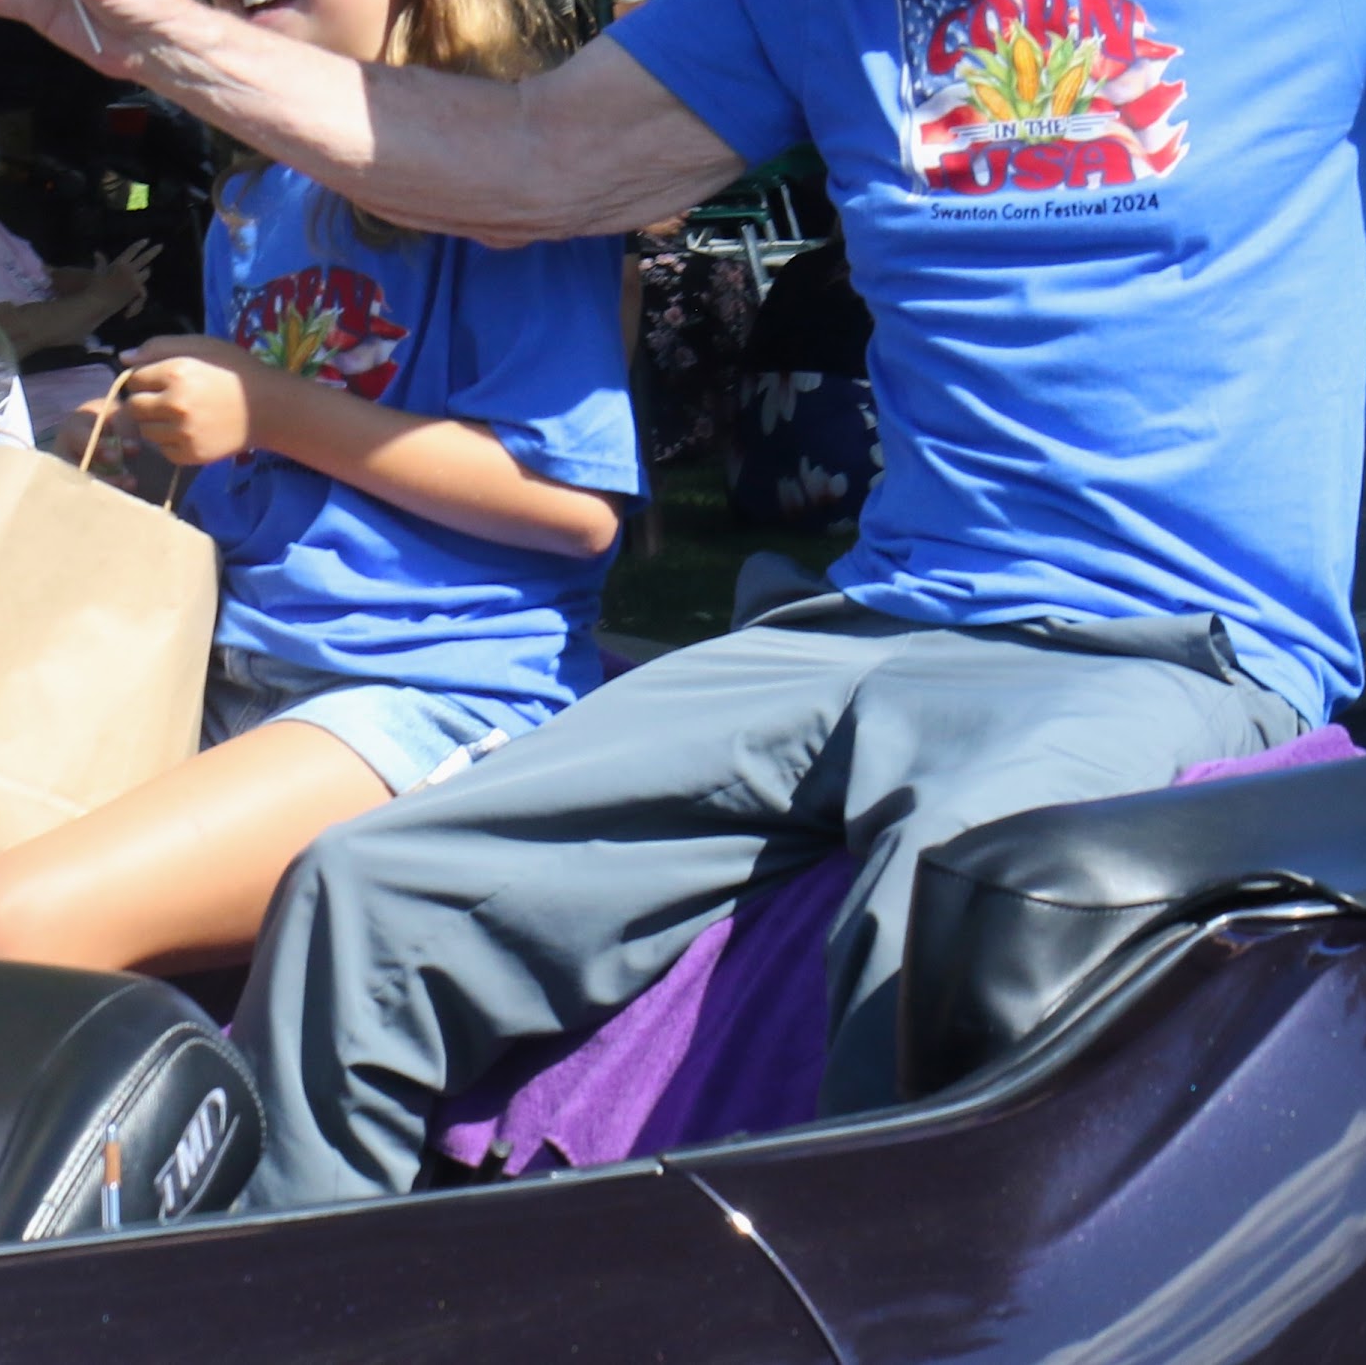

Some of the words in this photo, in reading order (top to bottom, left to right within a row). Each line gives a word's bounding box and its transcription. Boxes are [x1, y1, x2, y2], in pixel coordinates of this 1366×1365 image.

[993, 121, 1017, 139] IN
[1025, 118, 1067, 138] THE
[939, 141, 1136, 195] USA
[930, 203, 998, 222] Swanton
[1001, 203, 1041, 221] Corn
[1044, 198, 1108, 219] Festival
[1112, 192, 1159, 213] 2024
